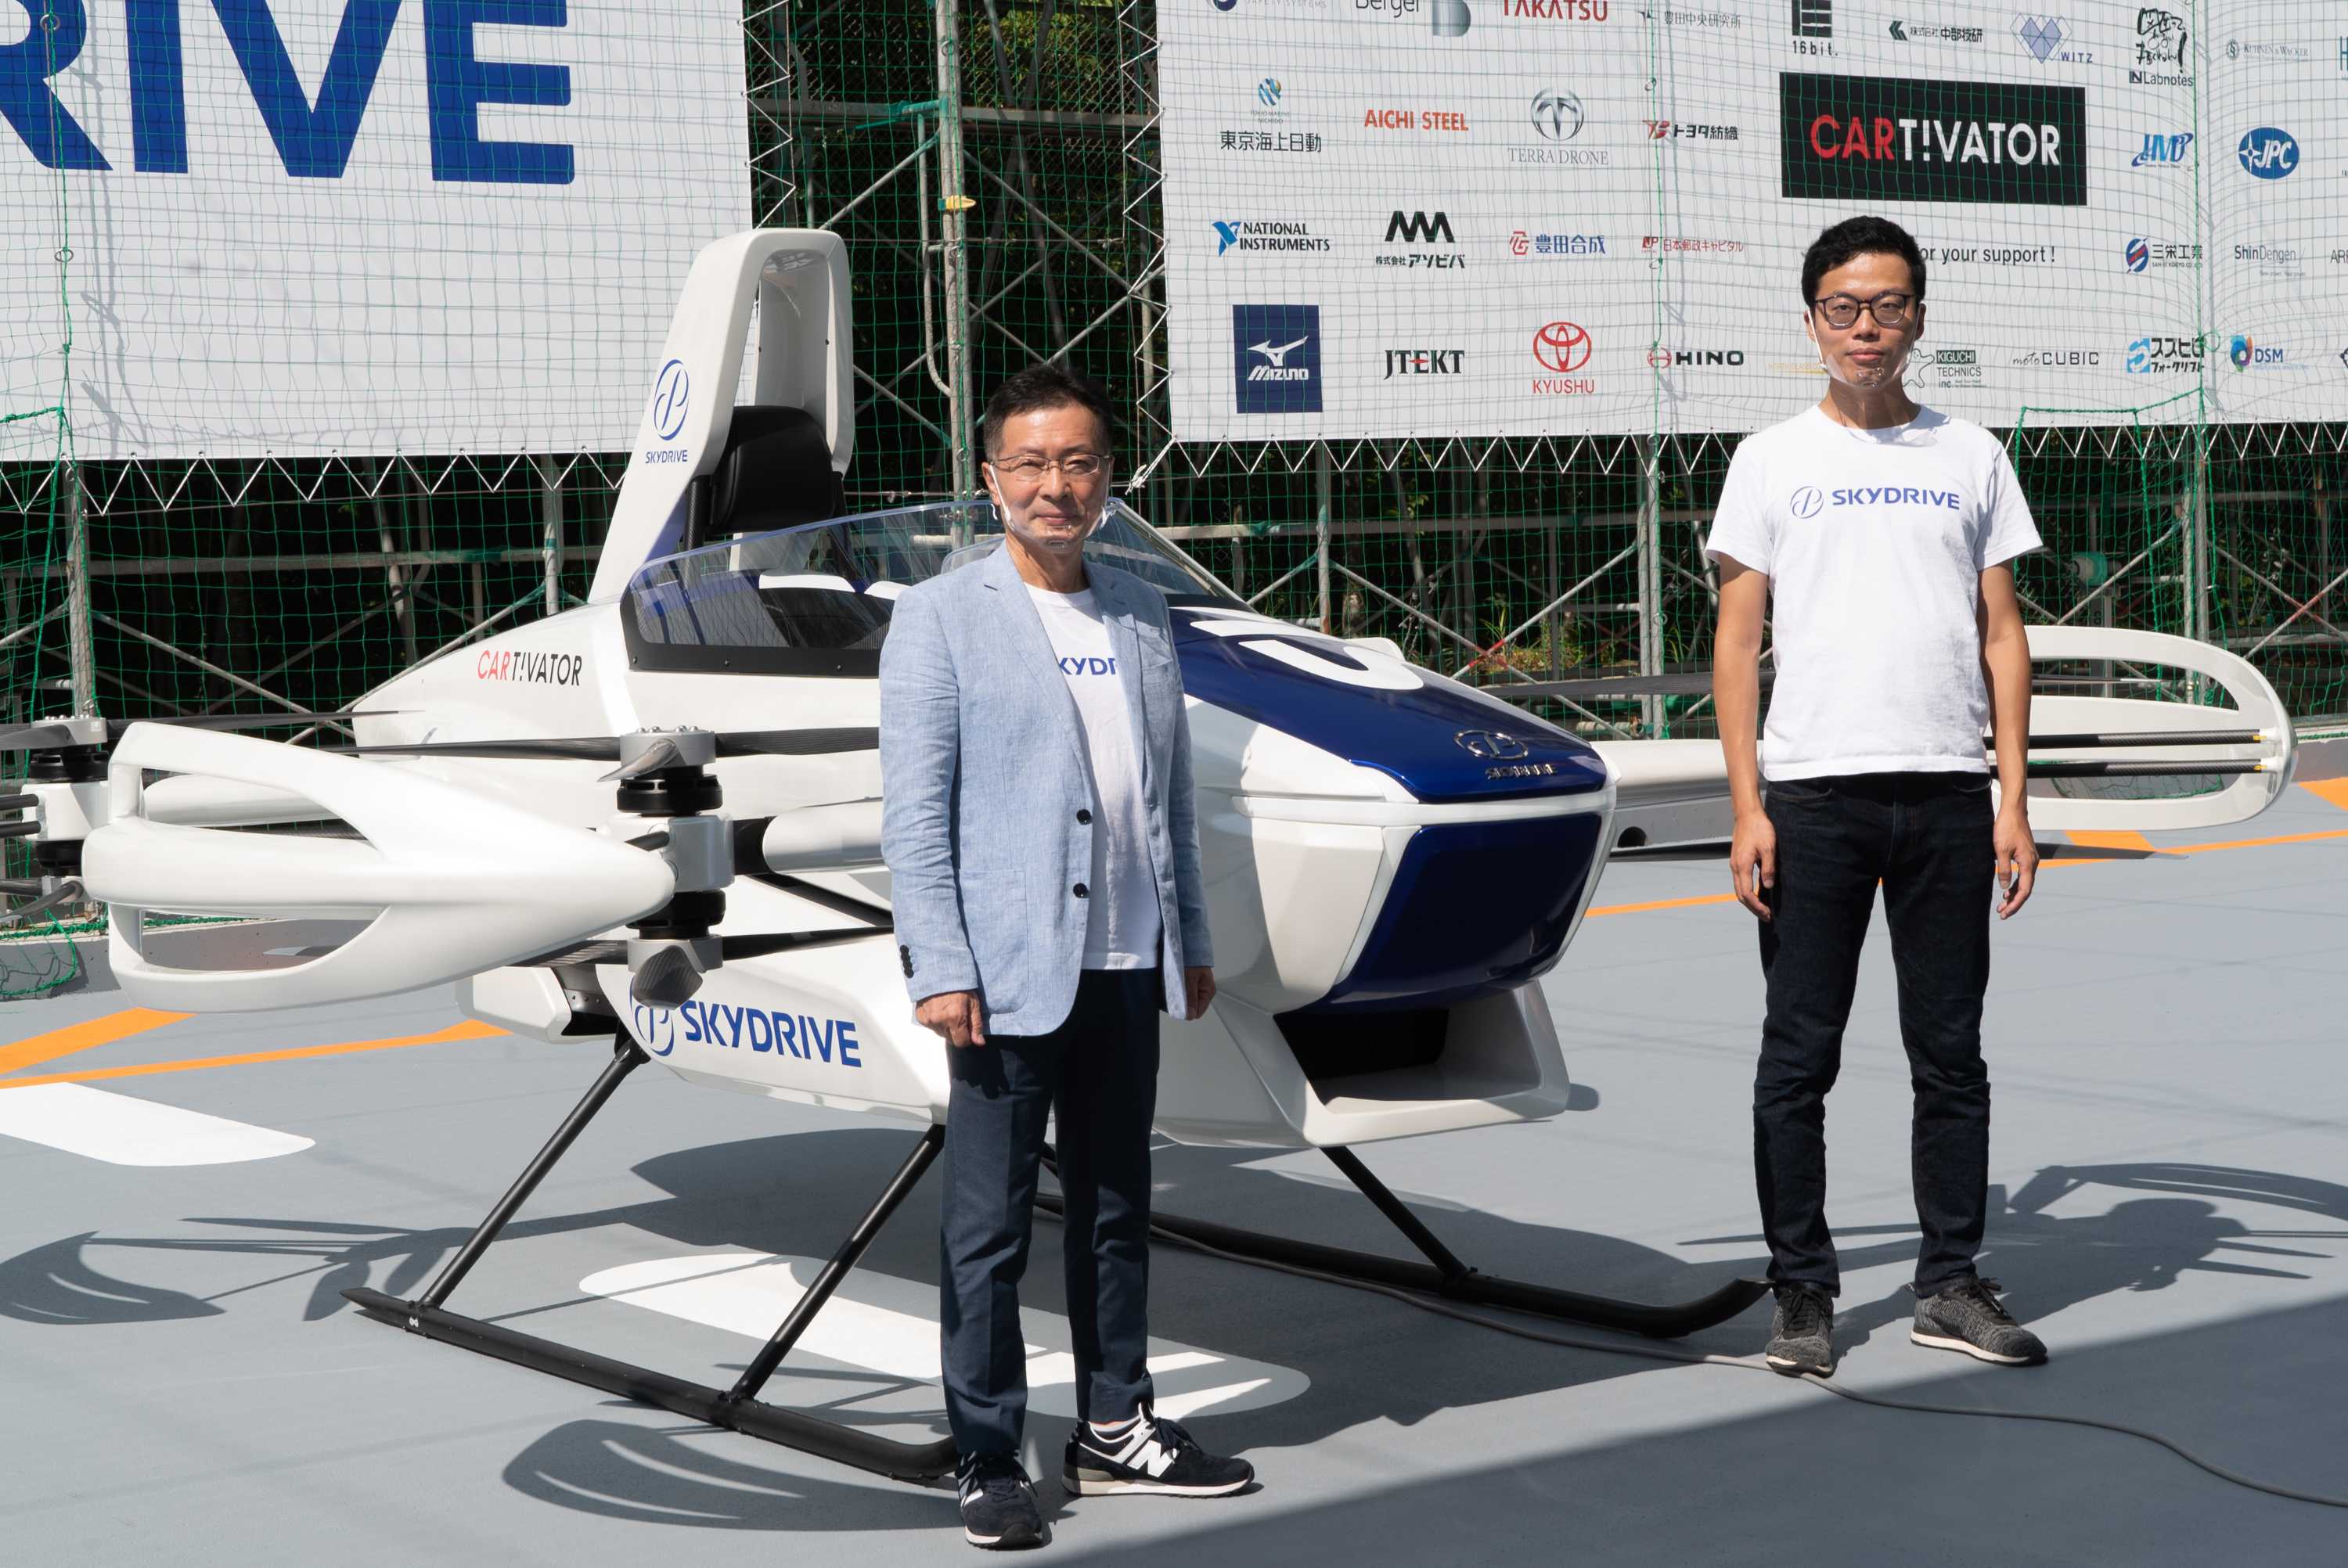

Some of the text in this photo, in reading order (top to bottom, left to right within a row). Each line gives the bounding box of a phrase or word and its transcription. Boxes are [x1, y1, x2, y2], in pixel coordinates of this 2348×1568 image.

[1503, 0, 1608, 22] TAKATSU
[2061, 51, 2094, 63] WITZ
[2144, 71, 2193, 86] Labnotes
[1364, 110, 1468, 131] AICHI STEEL
[1673, 124, 1739, 141] トヨタ紡織
[1220, 131, 1322, 153] 東京海上日動
[1507, 147, 1609, 165] TERRA DRONE
[2253, 139, 2292, 170] JPC
[1243, 221, 1309, 236] NATIONAL
[1239, 238, 1331, 251] INSTRUMENTS
[1534, 234, 1606, 254] 豊田合成
[1918, 247, 1936, 261] or
[1941, 247, 1977, 264] your
[1982, 246, 2046, 266] support
[2235, 245, 2296, 264] ShinDengen
[1676, 351, 1745, 365] HINO
[1937, 351, 1975, 363] KIGUCHI
[2255, 347, 2283, 363] DSM
[1383, 349, 1465, 381] JTEKT
[1936, 366, 1982, 377] TECHNICS
[1532, 379, 1595, 394] KYUSHU
[646, 449, 688, 464] SKYDRIVE
[1832, 487, 1960, 510] SKYDRIVE
[680, 999, 862, 1068] SKYDRIVE
